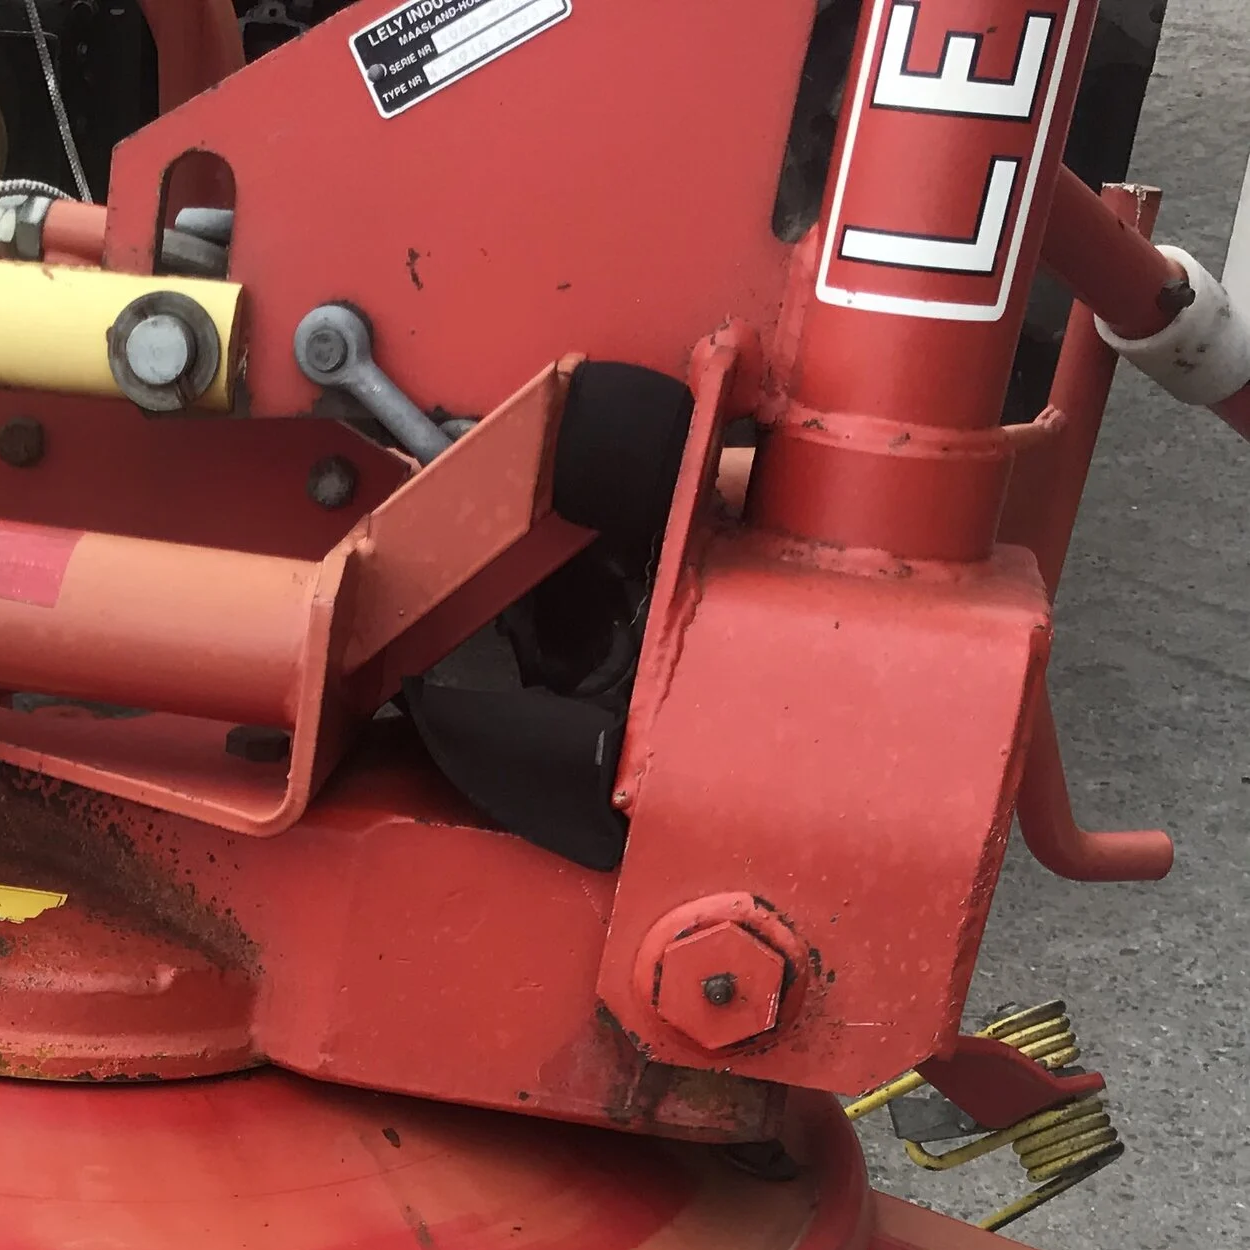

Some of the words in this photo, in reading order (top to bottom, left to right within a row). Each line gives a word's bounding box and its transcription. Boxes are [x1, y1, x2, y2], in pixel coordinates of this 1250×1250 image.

[367, 16, 403, 47] LELY
[389, 53, 417, 75] SERIE
[382, 83, 408, 102] TYPE
[838, 1, 1056, 277] LE
